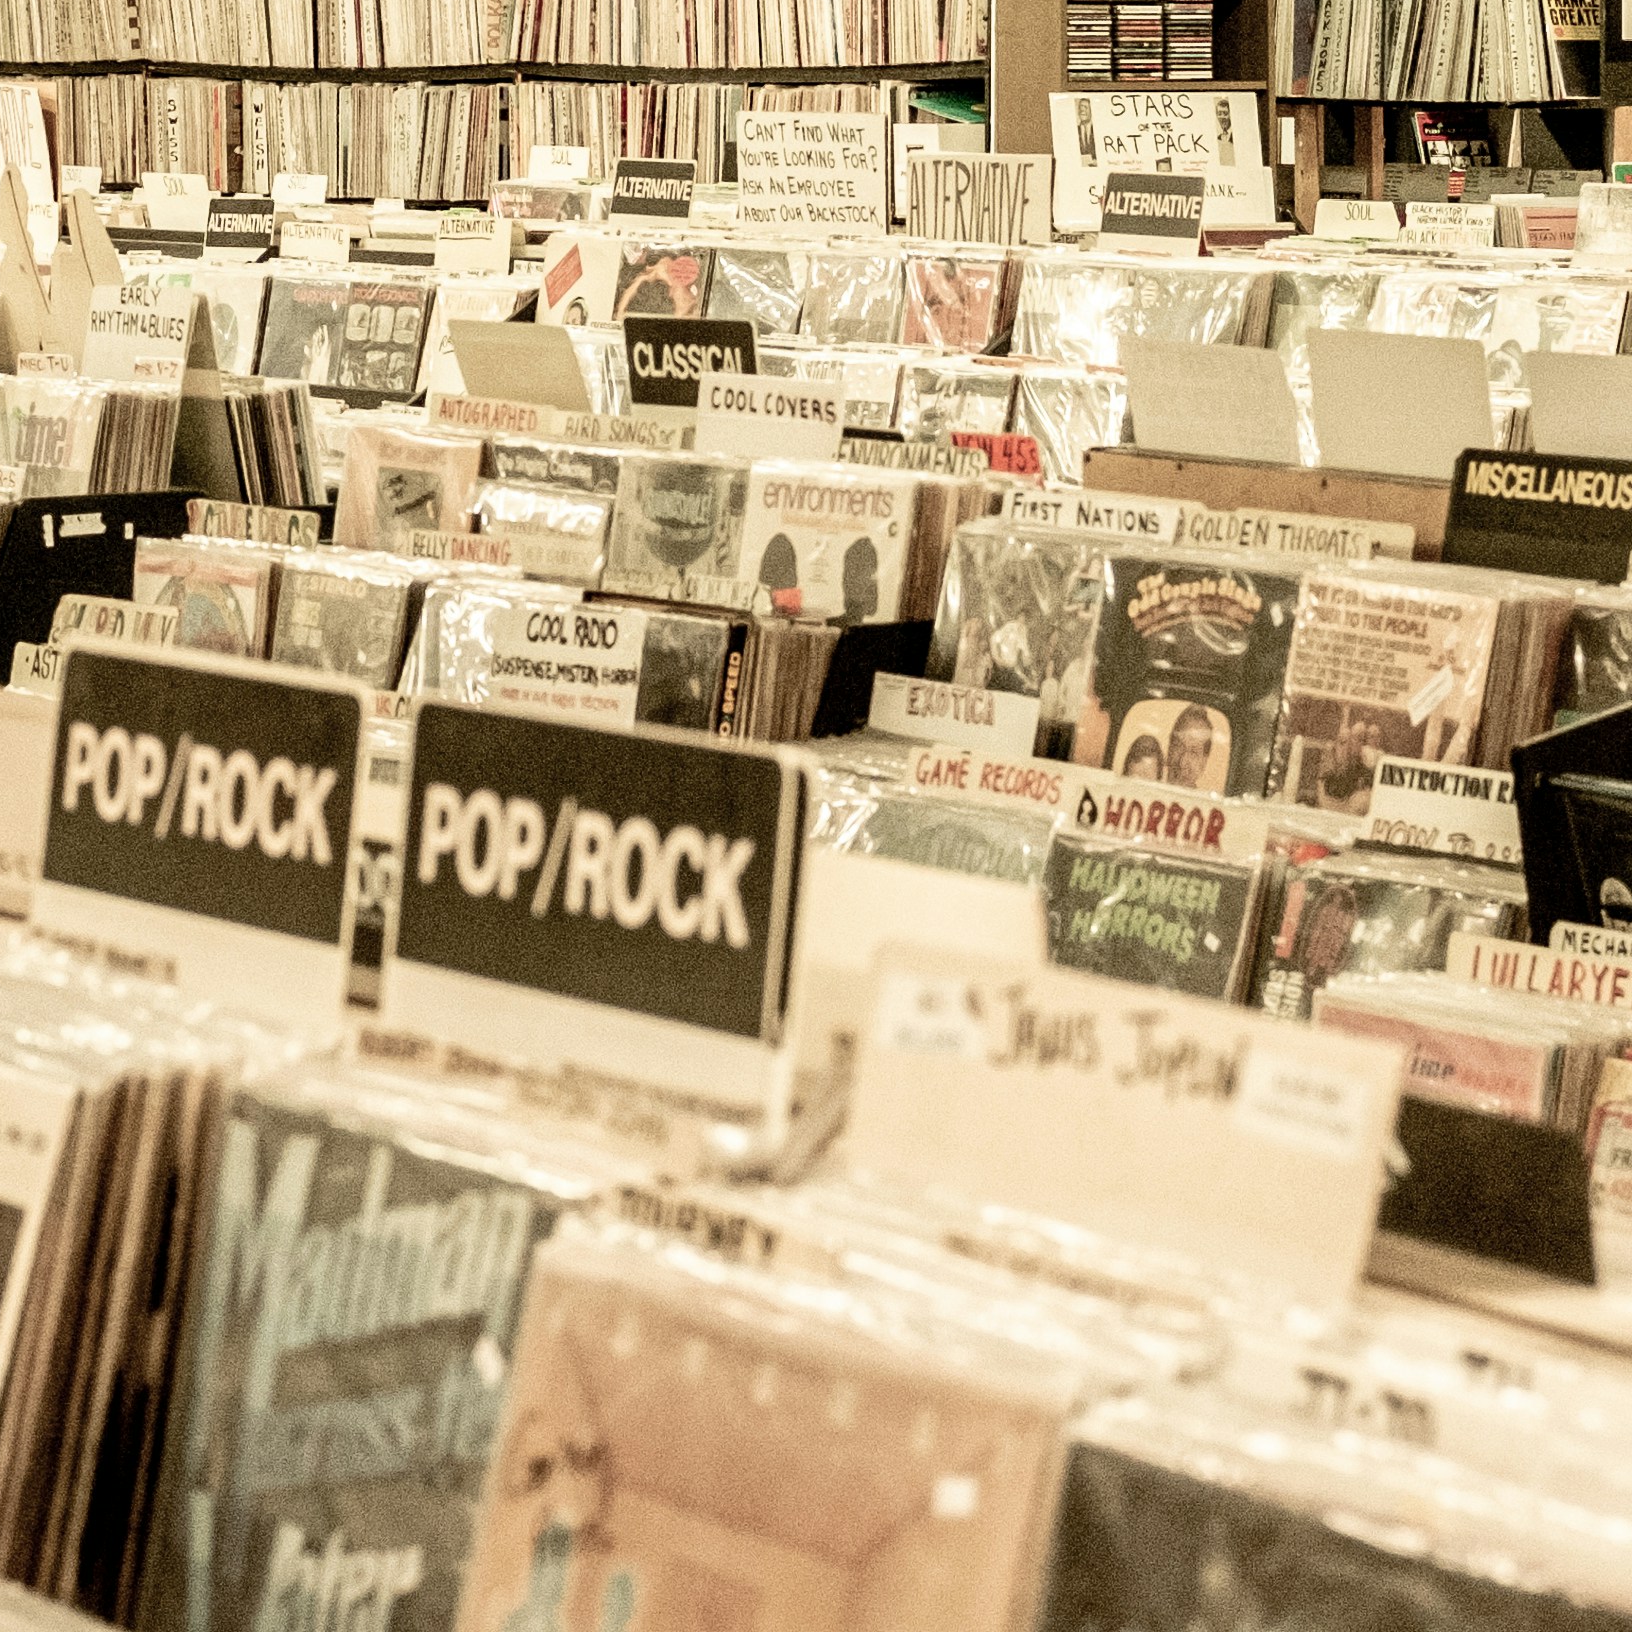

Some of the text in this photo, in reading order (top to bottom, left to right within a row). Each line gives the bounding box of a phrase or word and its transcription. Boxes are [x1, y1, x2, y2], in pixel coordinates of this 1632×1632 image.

[1111, 94, 1193, 119] STARS
[744, 119, 865, 147] CAN'T FIND WHAT
[1104, 133, 1209, 154] RAT PACK
[740, 145, 877, 172] YOU'RE LOOKING FOR?
[614, 176, 692, 202] ALTERNATIVE
[743, 176, 855, 198] ASK AN EMPLOYEE
[745, 206, 776, 222] ABOUT
[780, 204, 802, 222] OUR
[909, 161, 1035, 244] ALTERNATIVE
[1105, 192, 1202, 219] ALTERNATIVE
[1344, 202, 1374, 221] SOUL
[208, 213, 273, 234] ALTERNATIVE
[440, 219, 496, 236] ALTERNATIVE
[120, 287, 161, 308] EARLY
[633, 342, 743, 381] CLASSICAL
[439, 399, 539, 431] AUTOGRAPHED
[711, 386, 837, 424] COOL COVERS
[609, 418, 657, 445] SONGS
[763, 479, 894, 517] environments
[1011, 492, 1160, 535] FIRST NATIONS
[1190, 514, 1267, 546] GOLDEN
[527, 612, 567, 644] COOL
[917, 752, 1063, 805] GAME RECORDS
[62, 720, 340, 866] POP/ROCK
[417, 780, 755, 950] POP/ROCK
